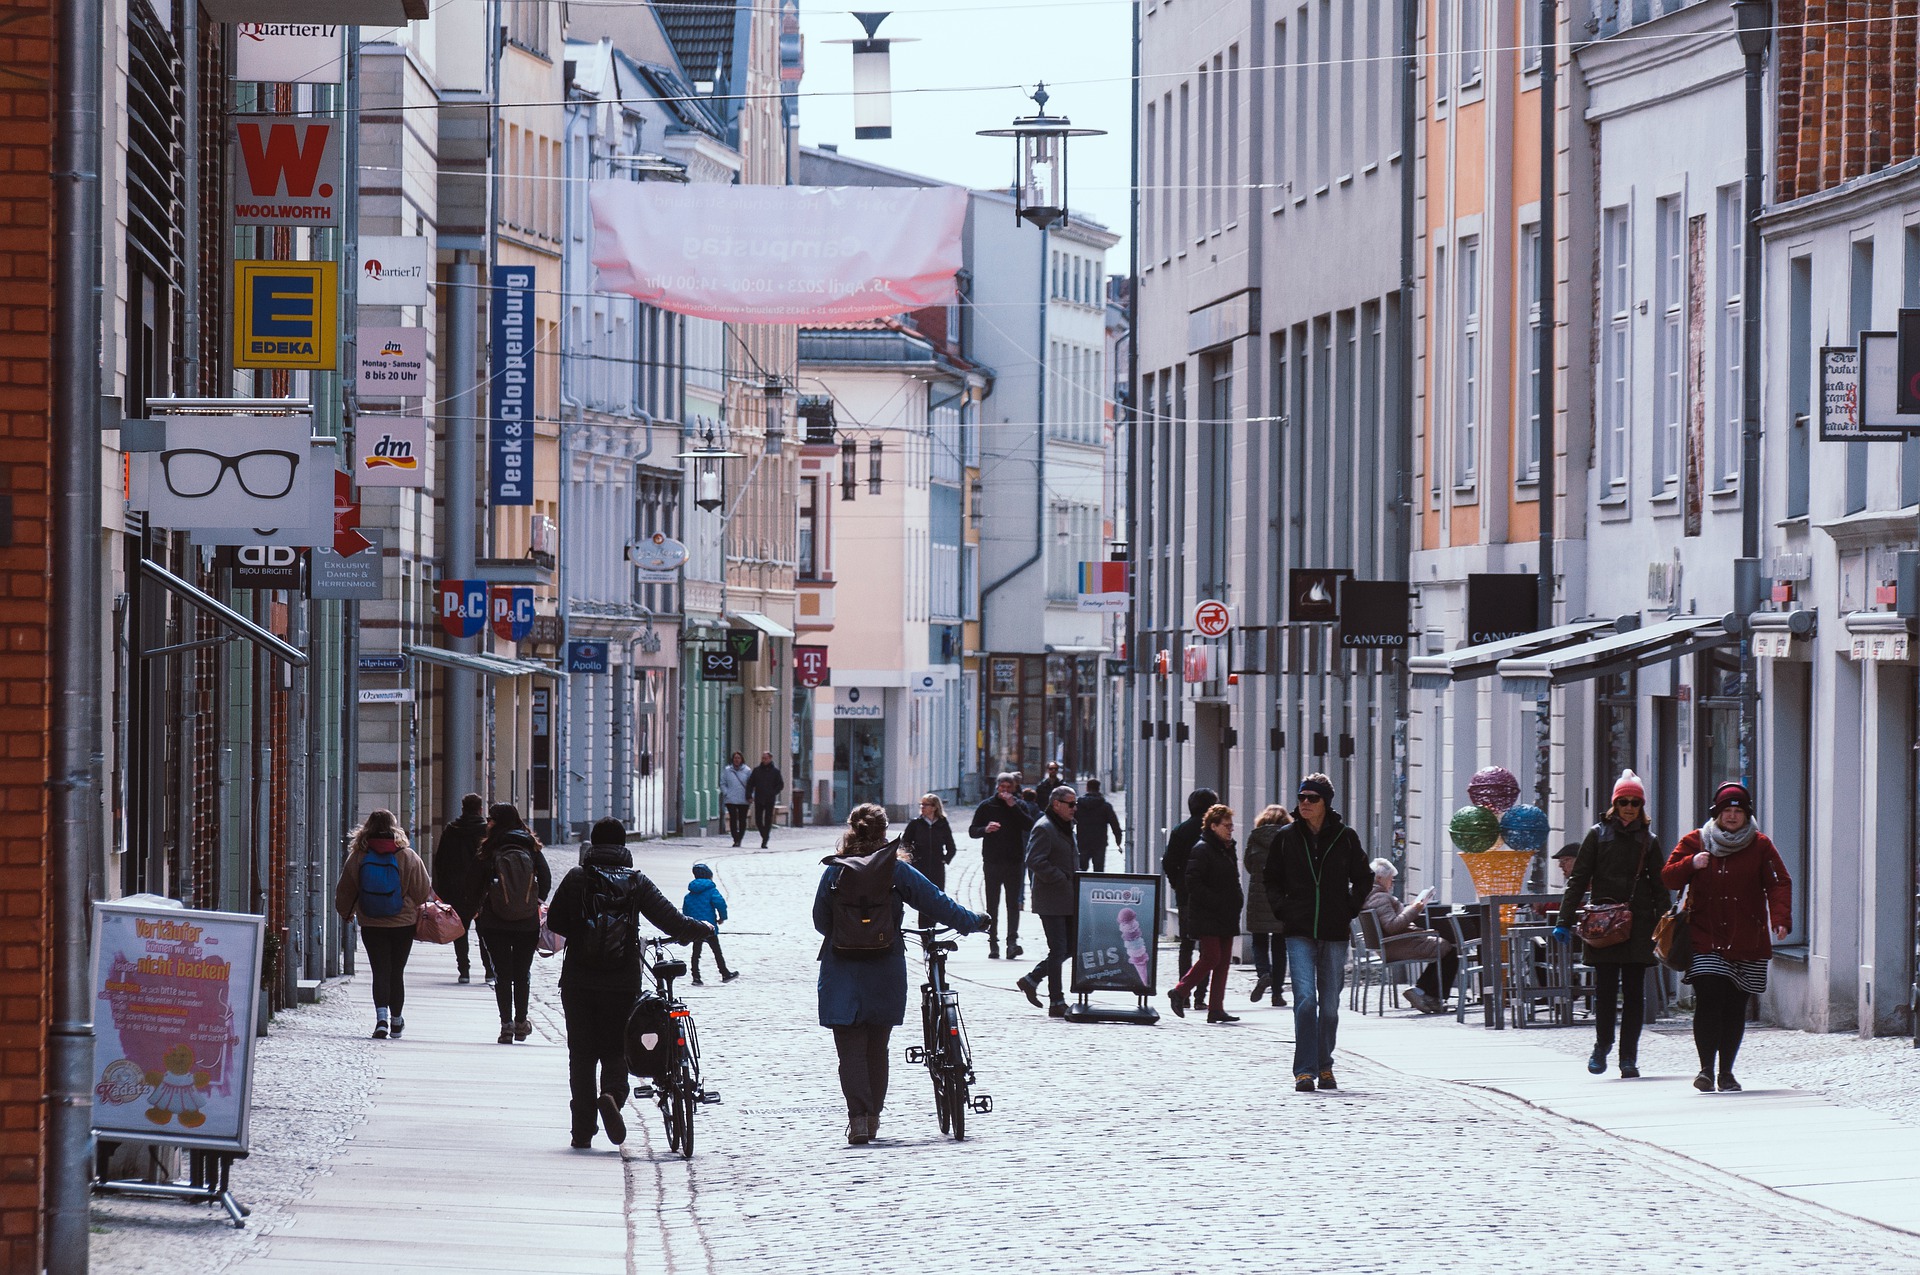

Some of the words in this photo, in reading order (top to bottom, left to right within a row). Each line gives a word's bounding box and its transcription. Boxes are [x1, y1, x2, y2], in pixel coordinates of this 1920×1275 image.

[235, 205, 331, 219] WOOLWORTH
[251, 341, 313, 355] EDEKA
[384, 341, 401, 351] dm
[362, 360, 387, 373] Montag
[392, 360, 421, 373] Samstag
[365, 371, 371, 380] 8
[372, 371, 386, 380] bis
[388, 371, 399, 380] 20
[401, 371, 417, 381] Uhr
[373, 434, 412, 458] dm
[324, 561, 371, 569] EXKLUSIVE
[239, 567, 260, 576] BIJOU
[261, 567, 293, 576] BRIGITTE
[317, 580, 377, 588] HERRENMODE
[443, 591, 483, 618] P&C
[494, 598, 530, 623] P&C
[1343, 634, 1403, 645] CANVERO
[573, 660, 602, 670] Apollo
[136, 917, 203, 943] Verkäufer
[1082, 946, 1120, 969] EIS
[138, 954, 174, 976] nicht
[176, 957, 231, 981] backen!
[1086, 968, 1122, 980] vergnügen
[160, 986, 178, 996] bitte
[209, 1023, 228, 1033] haben
